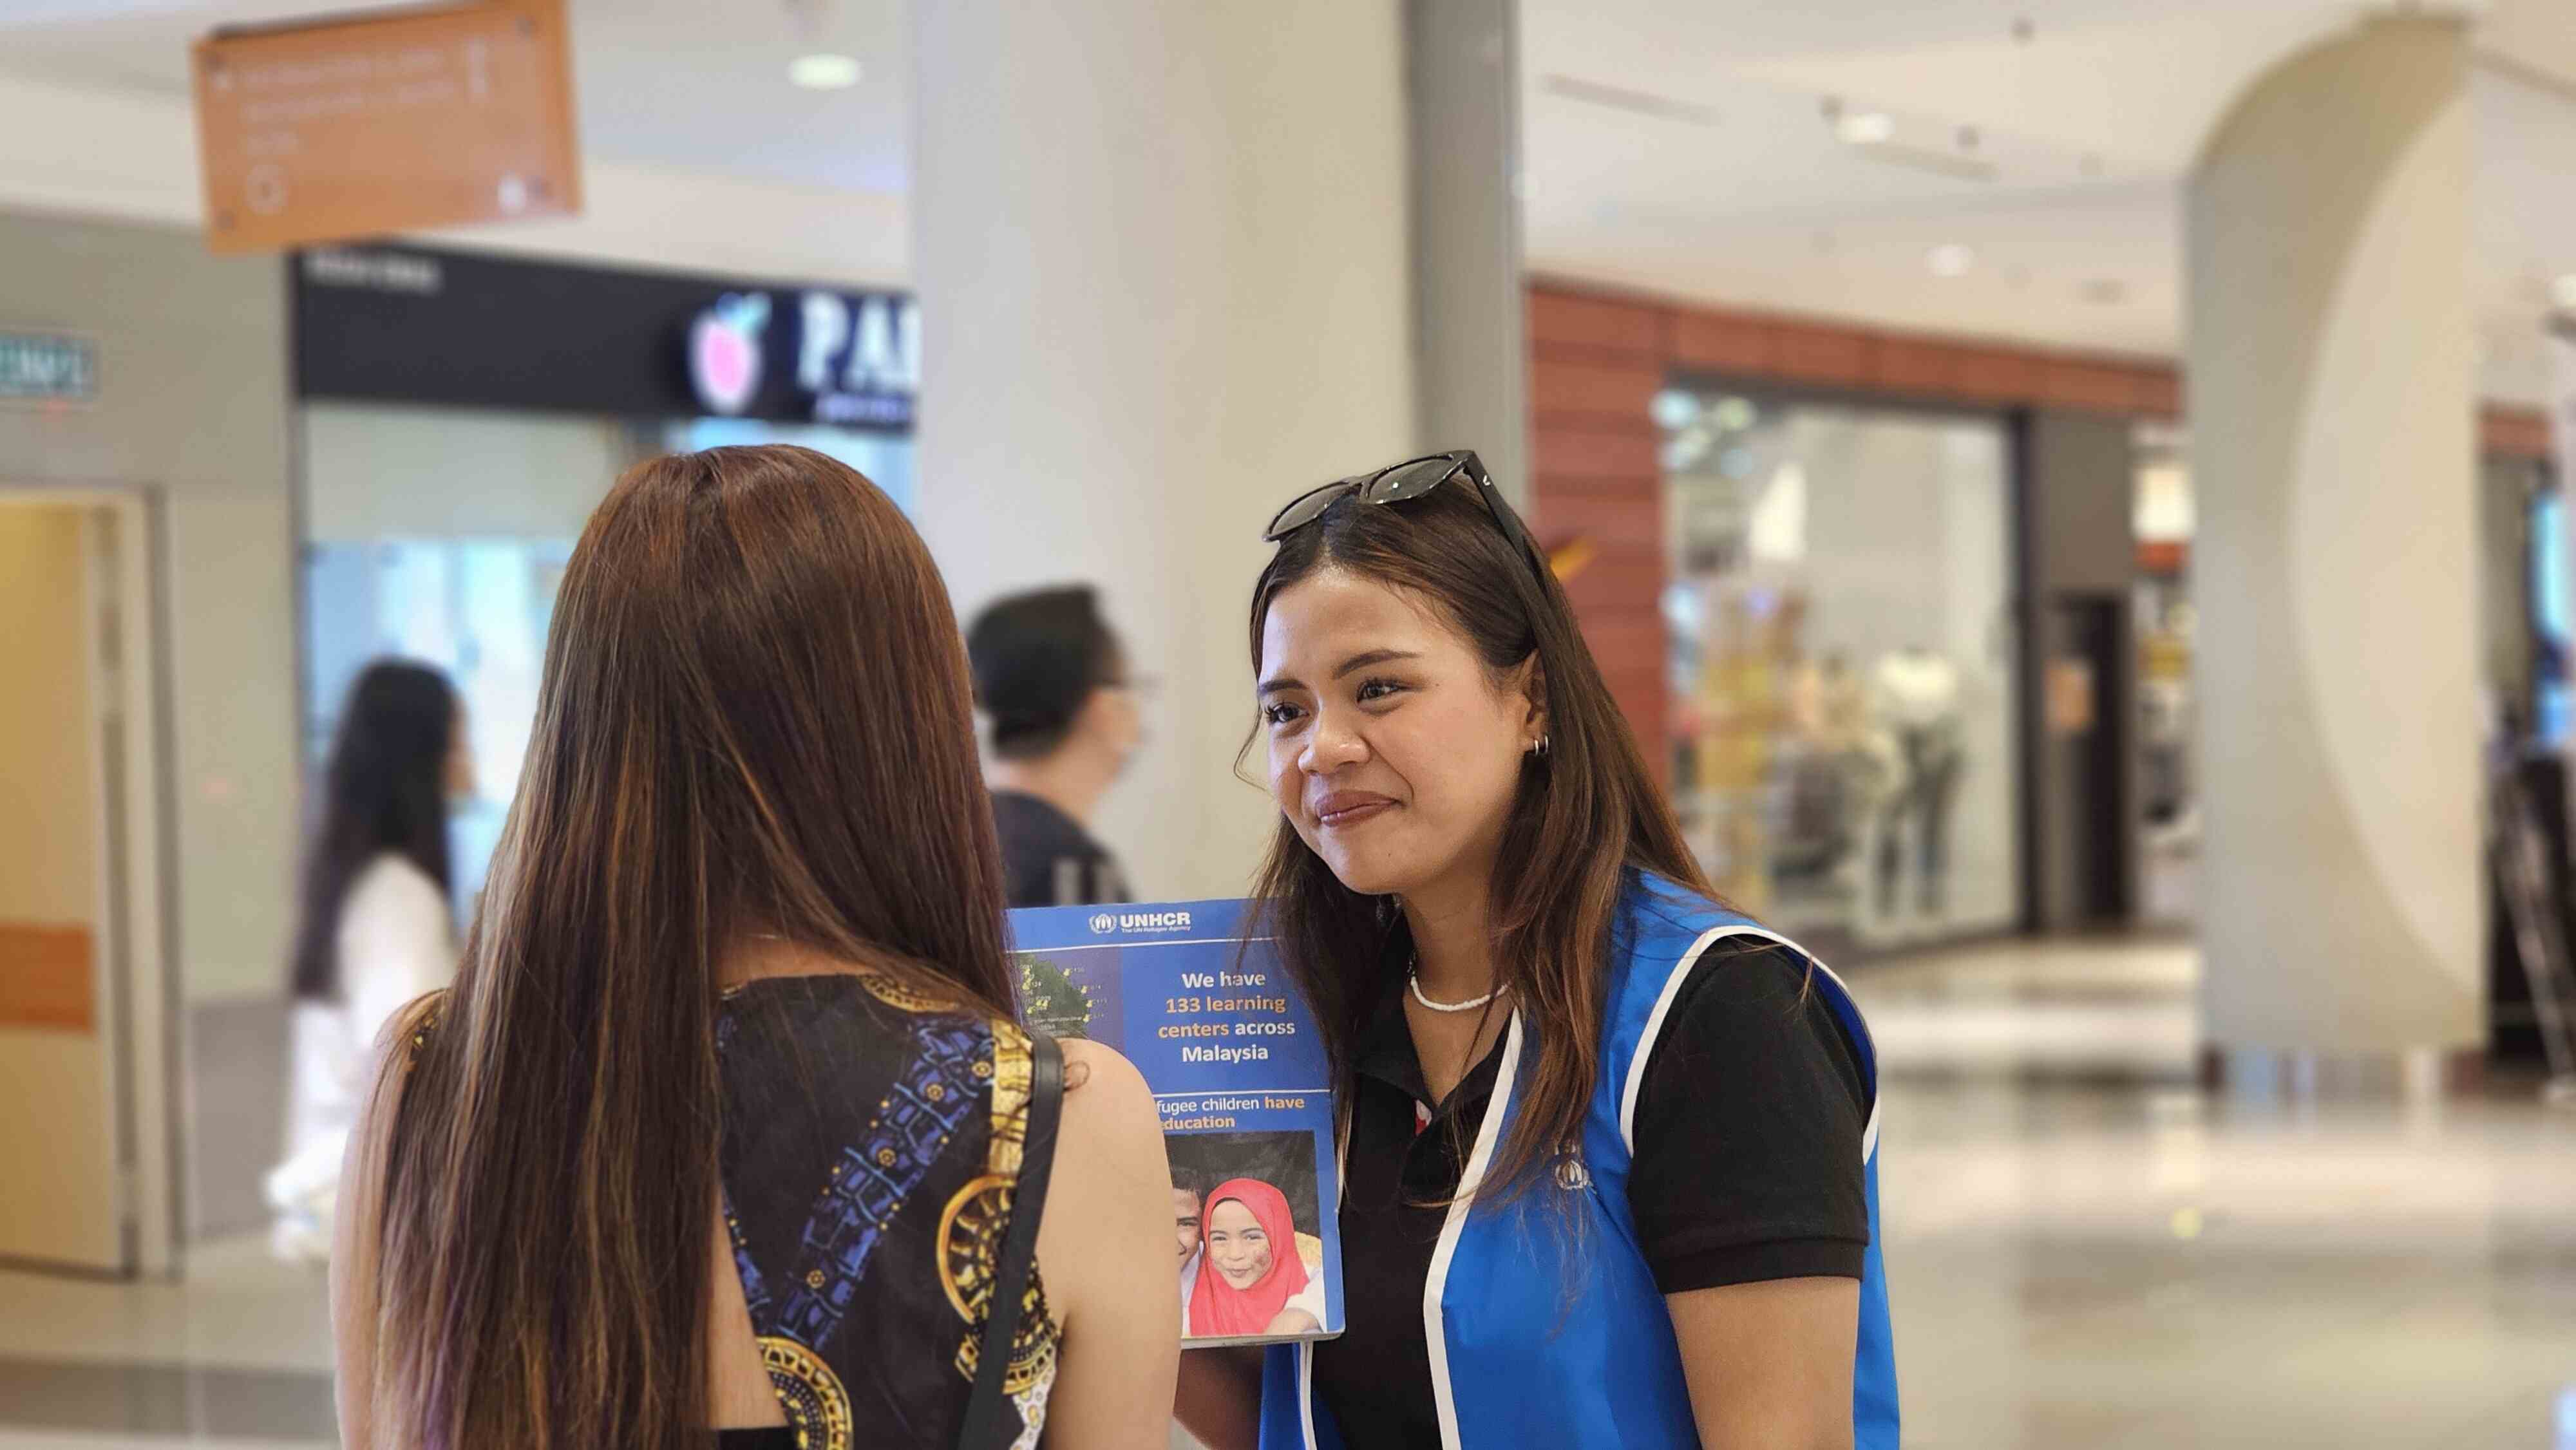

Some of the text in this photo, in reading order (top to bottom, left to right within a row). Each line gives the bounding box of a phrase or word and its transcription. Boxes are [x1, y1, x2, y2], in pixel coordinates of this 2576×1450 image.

[1120, 912, 1191, 928] UNHCR
[1182, 971, 1266, 988] We have
[1166, 995, 1286, 1013] 133 learning
[1158, 1022, 1296, 1039] centers across
[1182, 1044, 1269, 1064] Malaysia
[1202, 1098, 1260, 1112] children
[1265, 1097, 1305, 1109] have
